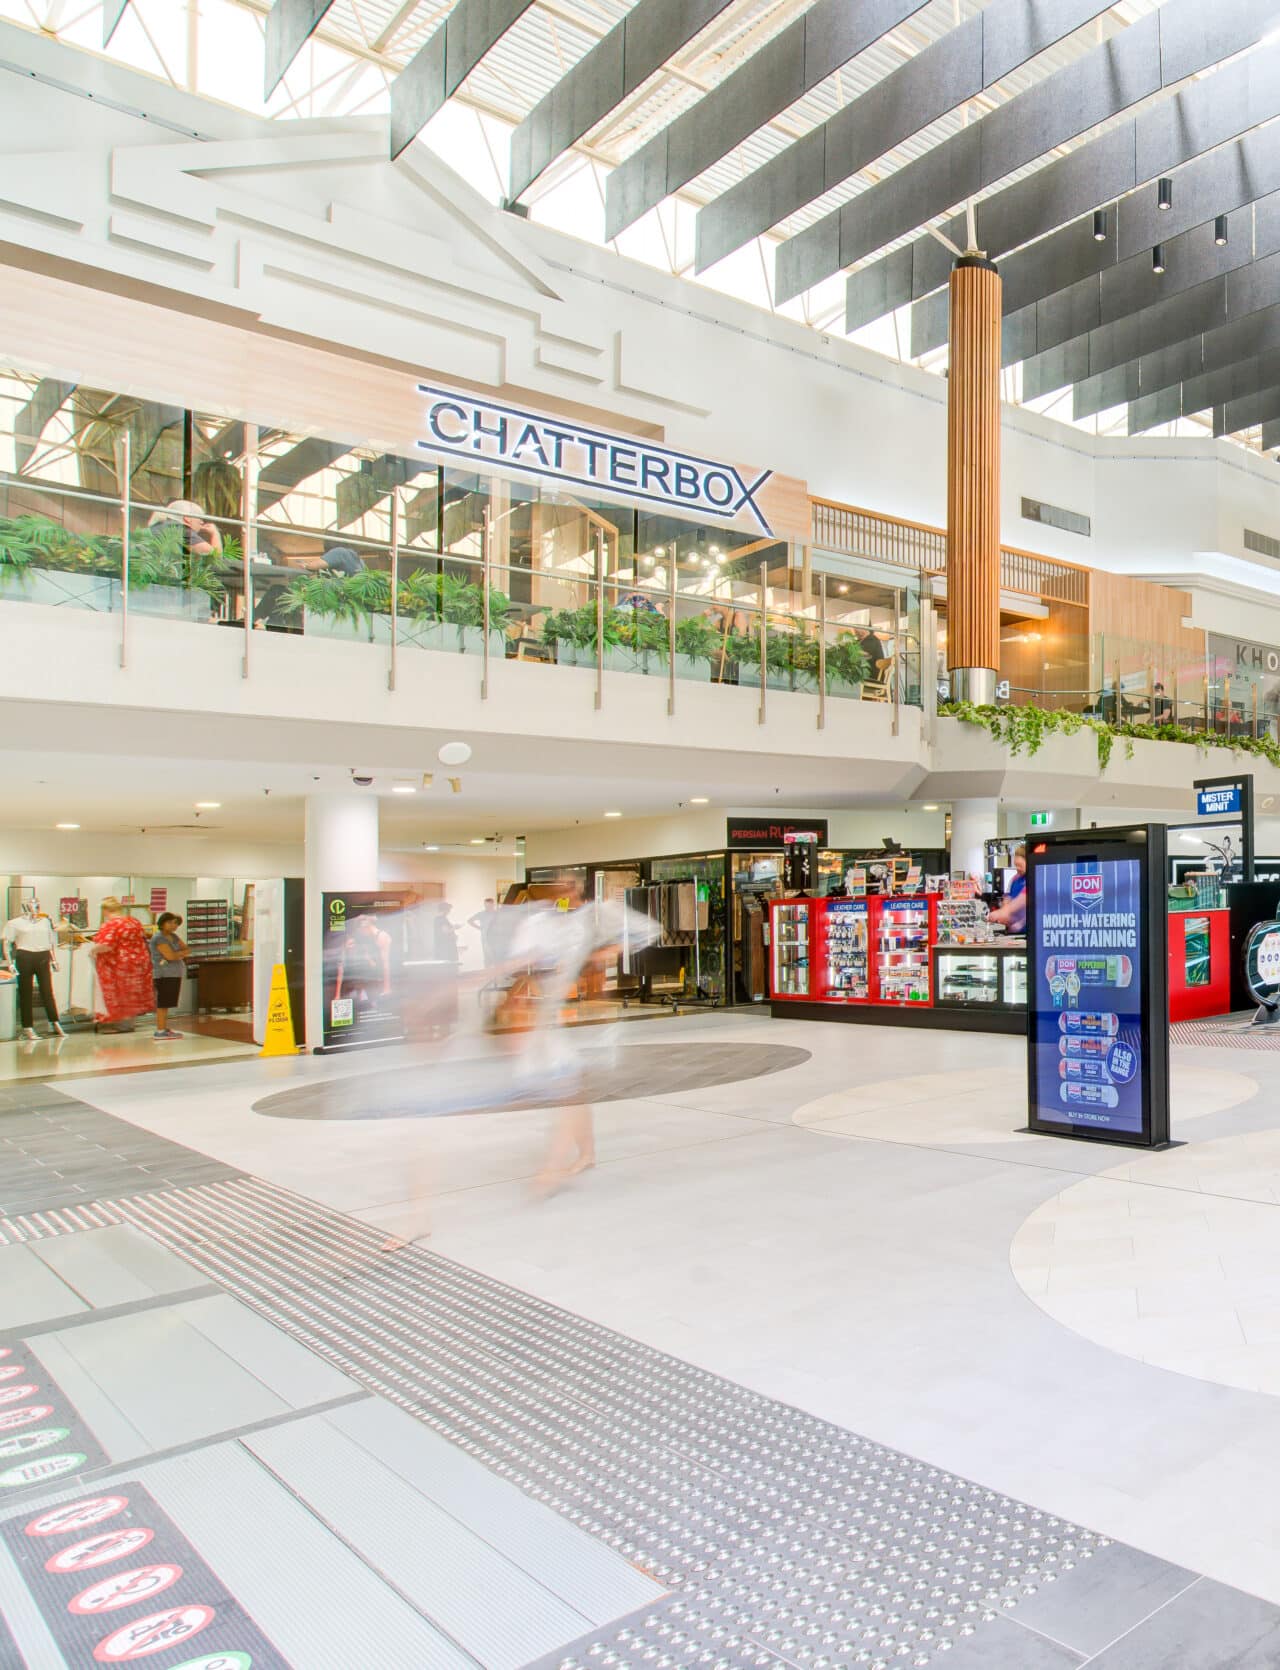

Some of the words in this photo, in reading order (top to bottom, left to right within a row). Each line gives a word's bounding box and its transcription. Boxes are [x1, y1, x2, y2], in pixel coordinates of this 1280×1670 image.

[429, 400, 774, 540] CHATTERBOX
[1201, 791, 1234, 804] MISTER
[1206, 801, 1229, 812] MINIT
[731, 829, 768, 839] PERSIAN
[1074, 877, 1100, 890] DON
[60, 903, 79, 912] $20
[890, 902, 910, 910] LEATHER
[1043, 913, 1136, 929] MOUTH-WATERING
[1043, 928, 1137, 948] ENTERTAINING
[1060, 960, 1075, 969] DON
[1113, 1047, 1132, 1062] ALSO
